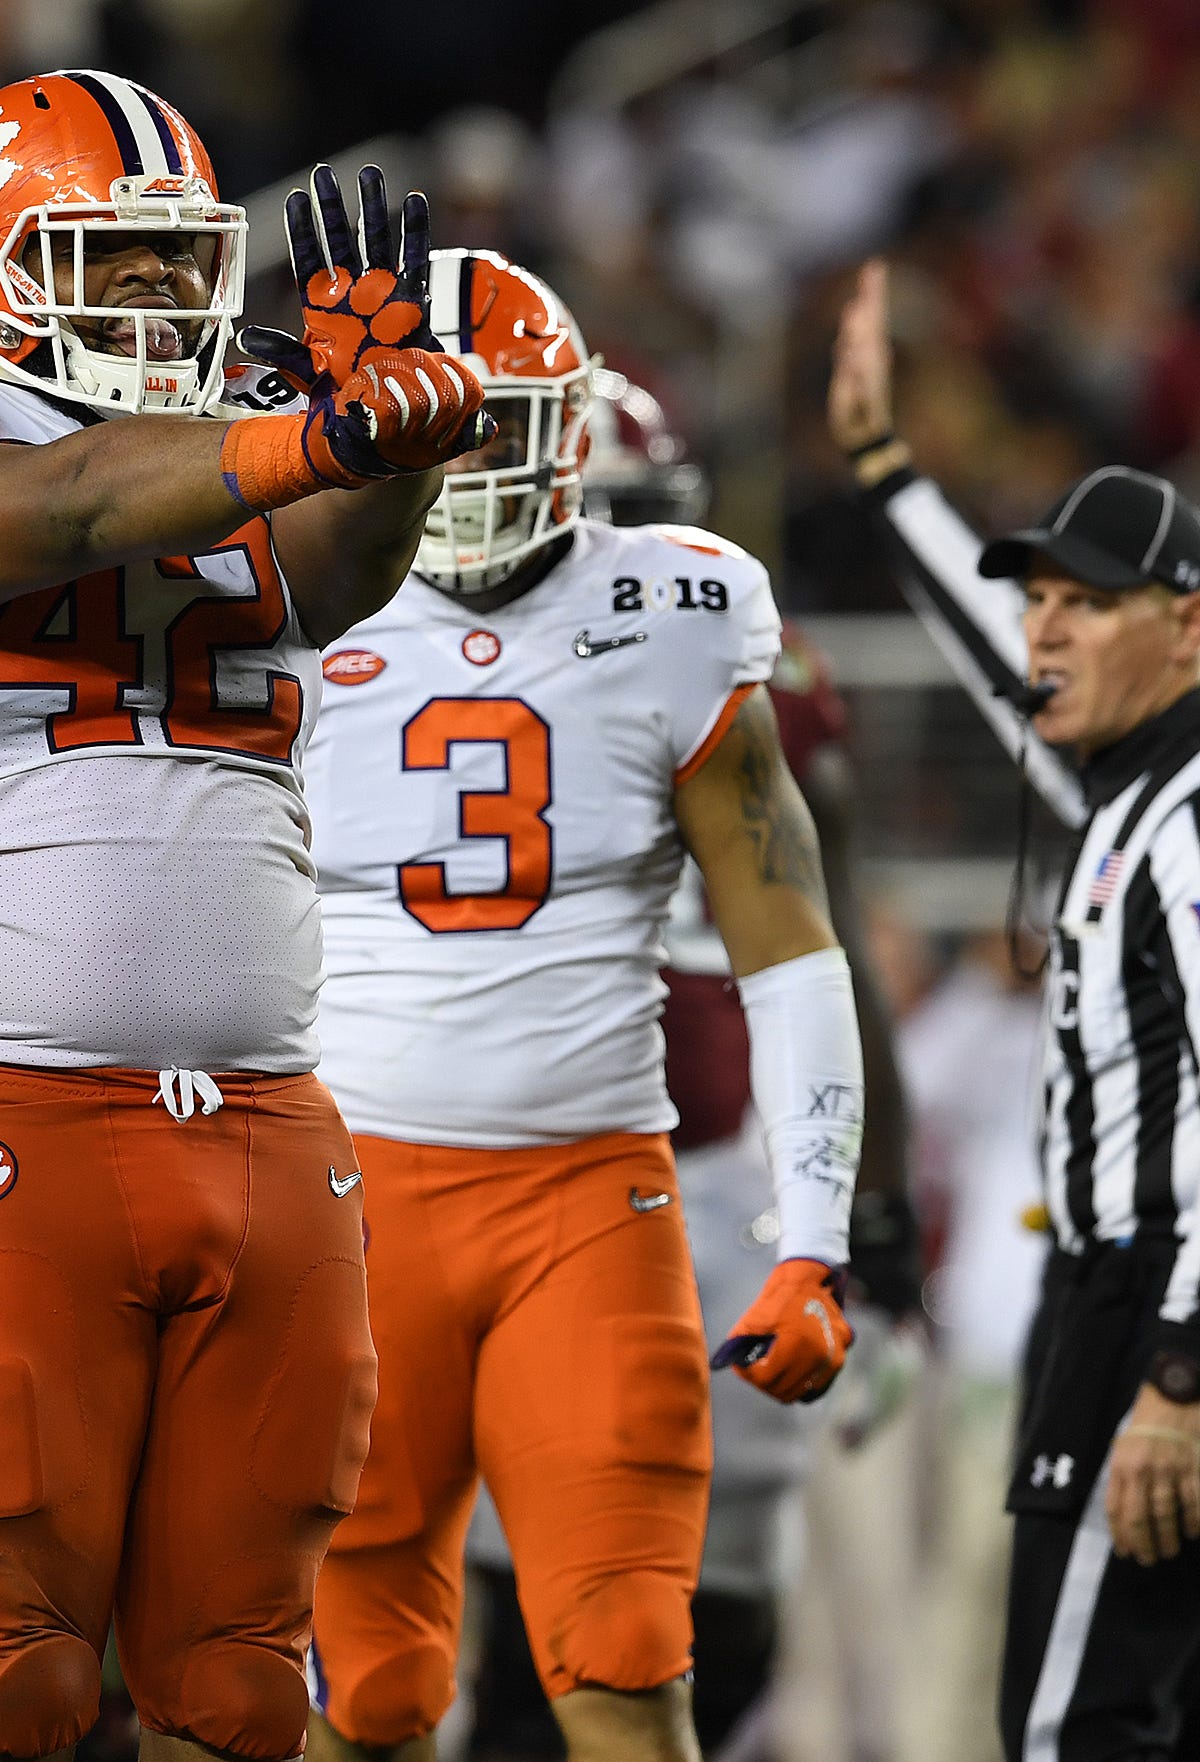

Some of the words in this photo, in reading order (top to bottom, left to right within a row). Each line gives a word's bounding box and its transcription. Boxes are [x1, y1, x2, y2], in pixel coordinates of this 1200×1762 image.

[144, 178, 185, 192] ACC
[165, 378, 178, 392] IN
[612, 577, 728, 612] 2019
[324, 653, 378, 675] ACC
[397, 696, 552, 934] 3
